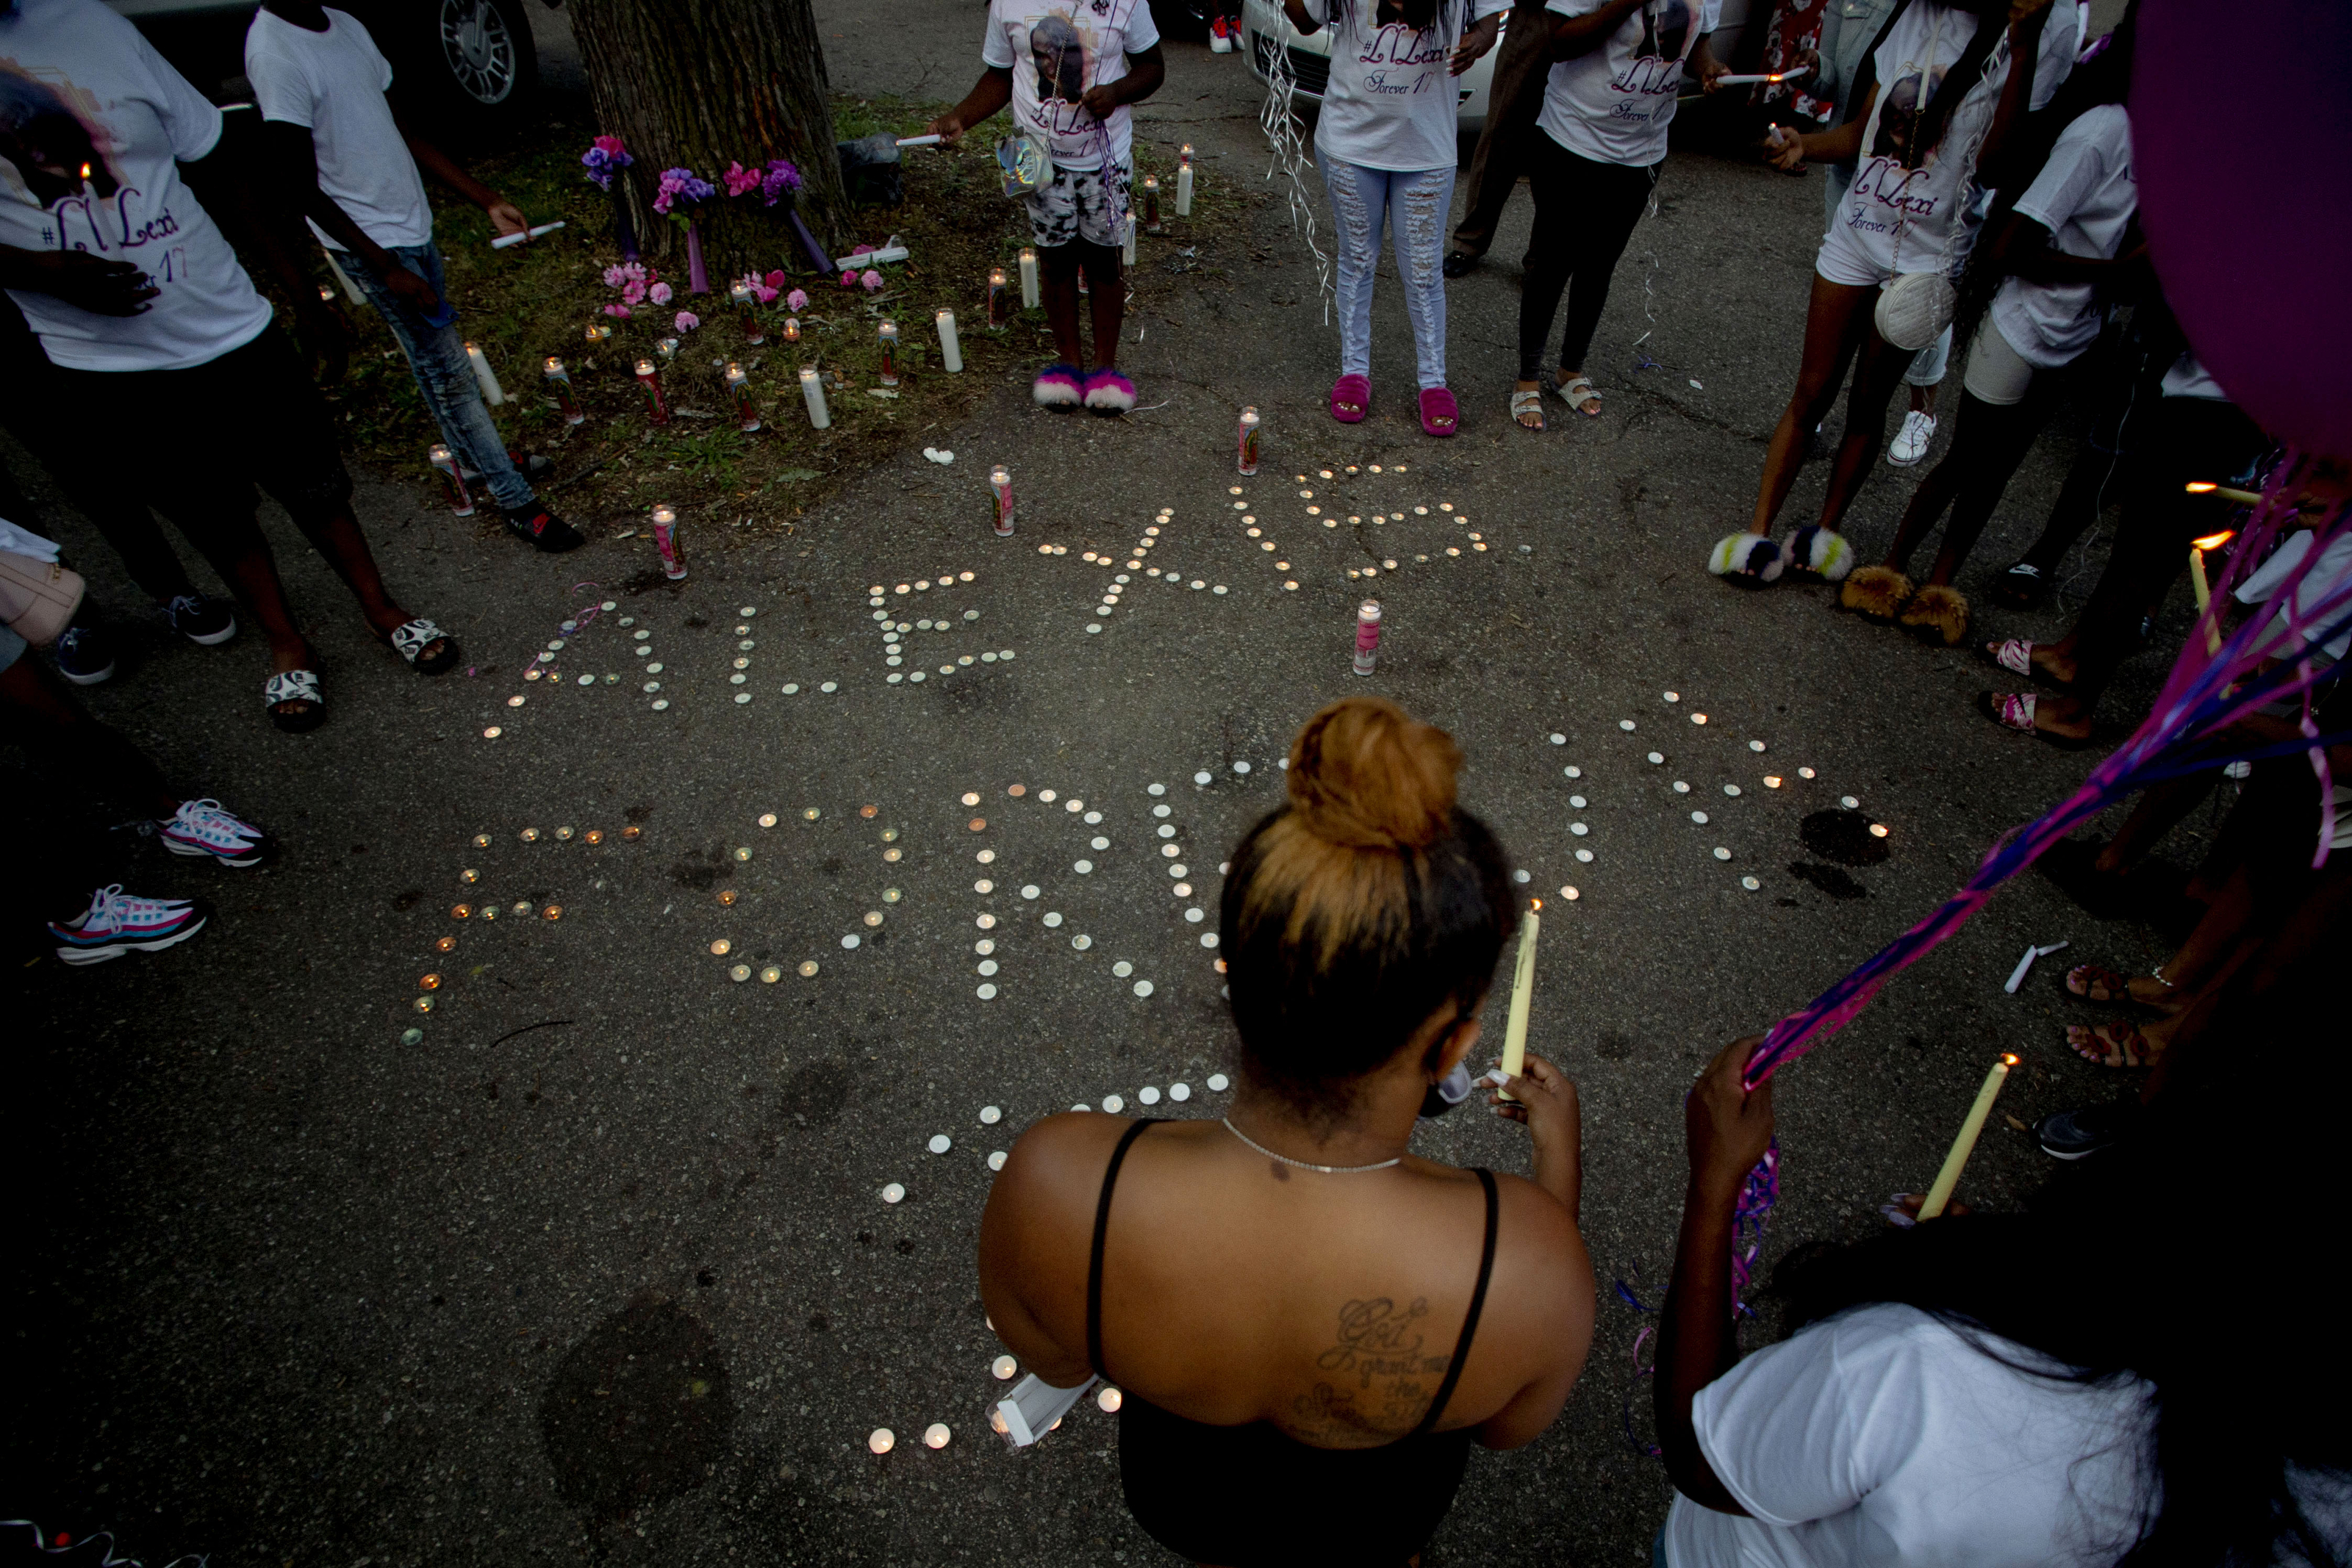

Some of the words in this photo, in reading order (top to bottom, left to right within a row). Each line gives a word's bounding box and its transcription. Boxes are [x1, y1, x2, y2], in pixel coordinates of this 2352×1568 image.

[1395, 26, 1444, 65] Lexi
[1363, 68, 1410, 94] Forever
[1413, 71, 1437, 94] 17
[1058, 104, 1101, 135] Lex
[1610, 97, 1649, 121] Forever
[1878, 170, 1939, 216] Lexi
[119, 187, 179, 247] Lexi
[1848, 202, 1887, 233] Forever
[159, 247, 187, 282] 17
